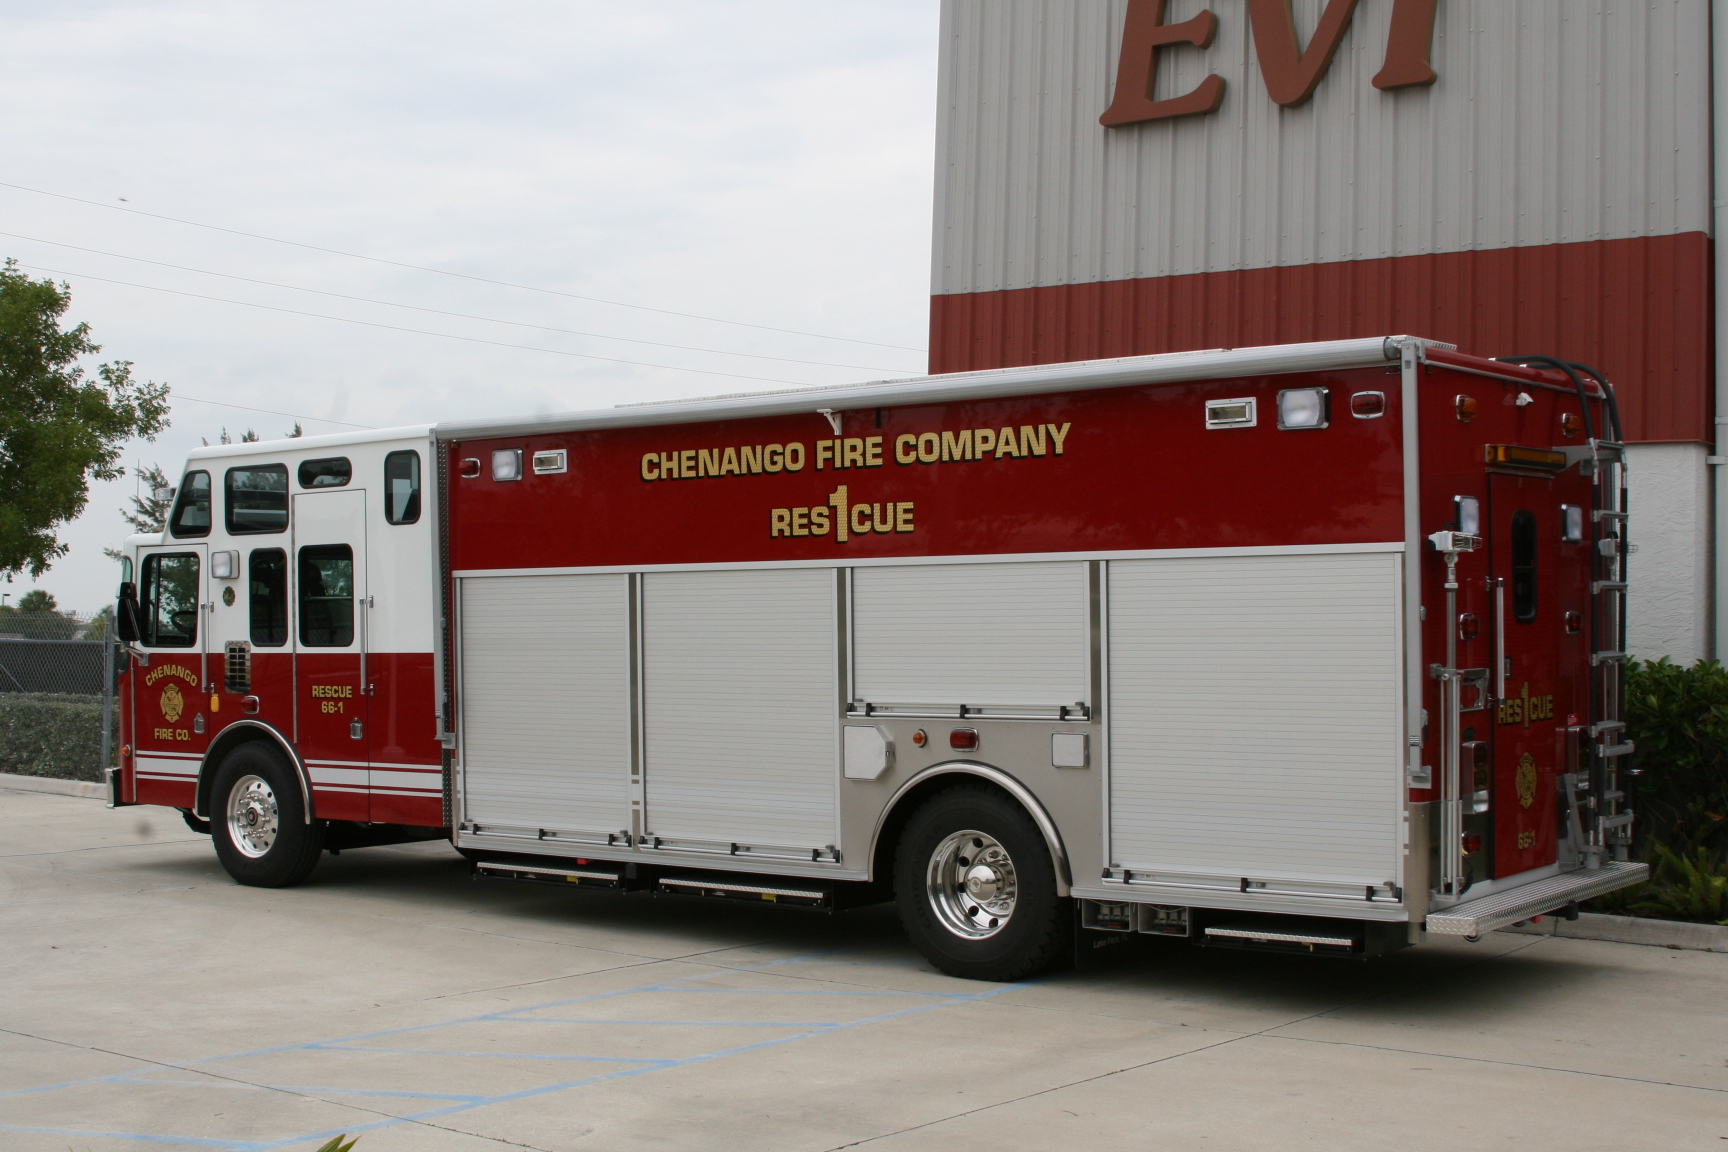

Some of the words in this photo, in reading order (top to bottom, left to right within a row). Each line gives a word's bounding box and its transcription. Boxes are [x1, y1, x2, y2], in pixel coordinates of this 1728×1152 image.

[1099, 0, 1440, 128] EVI
[640, 441, 806, 481] CHENANGO
[816, 435, 885, 470] FIRE
[895, 421, 1073, 464] COMPANY
[145, 664, 198, 687] CHENANGO
[311, 685, 353, 699] RESCUE
[321, 701, 343, 714] 66-1
[154, 727, 174, 741] FIRE
[175, 728, 191, 741] CO.
[1518, 830, 1536, 850] 66-1
